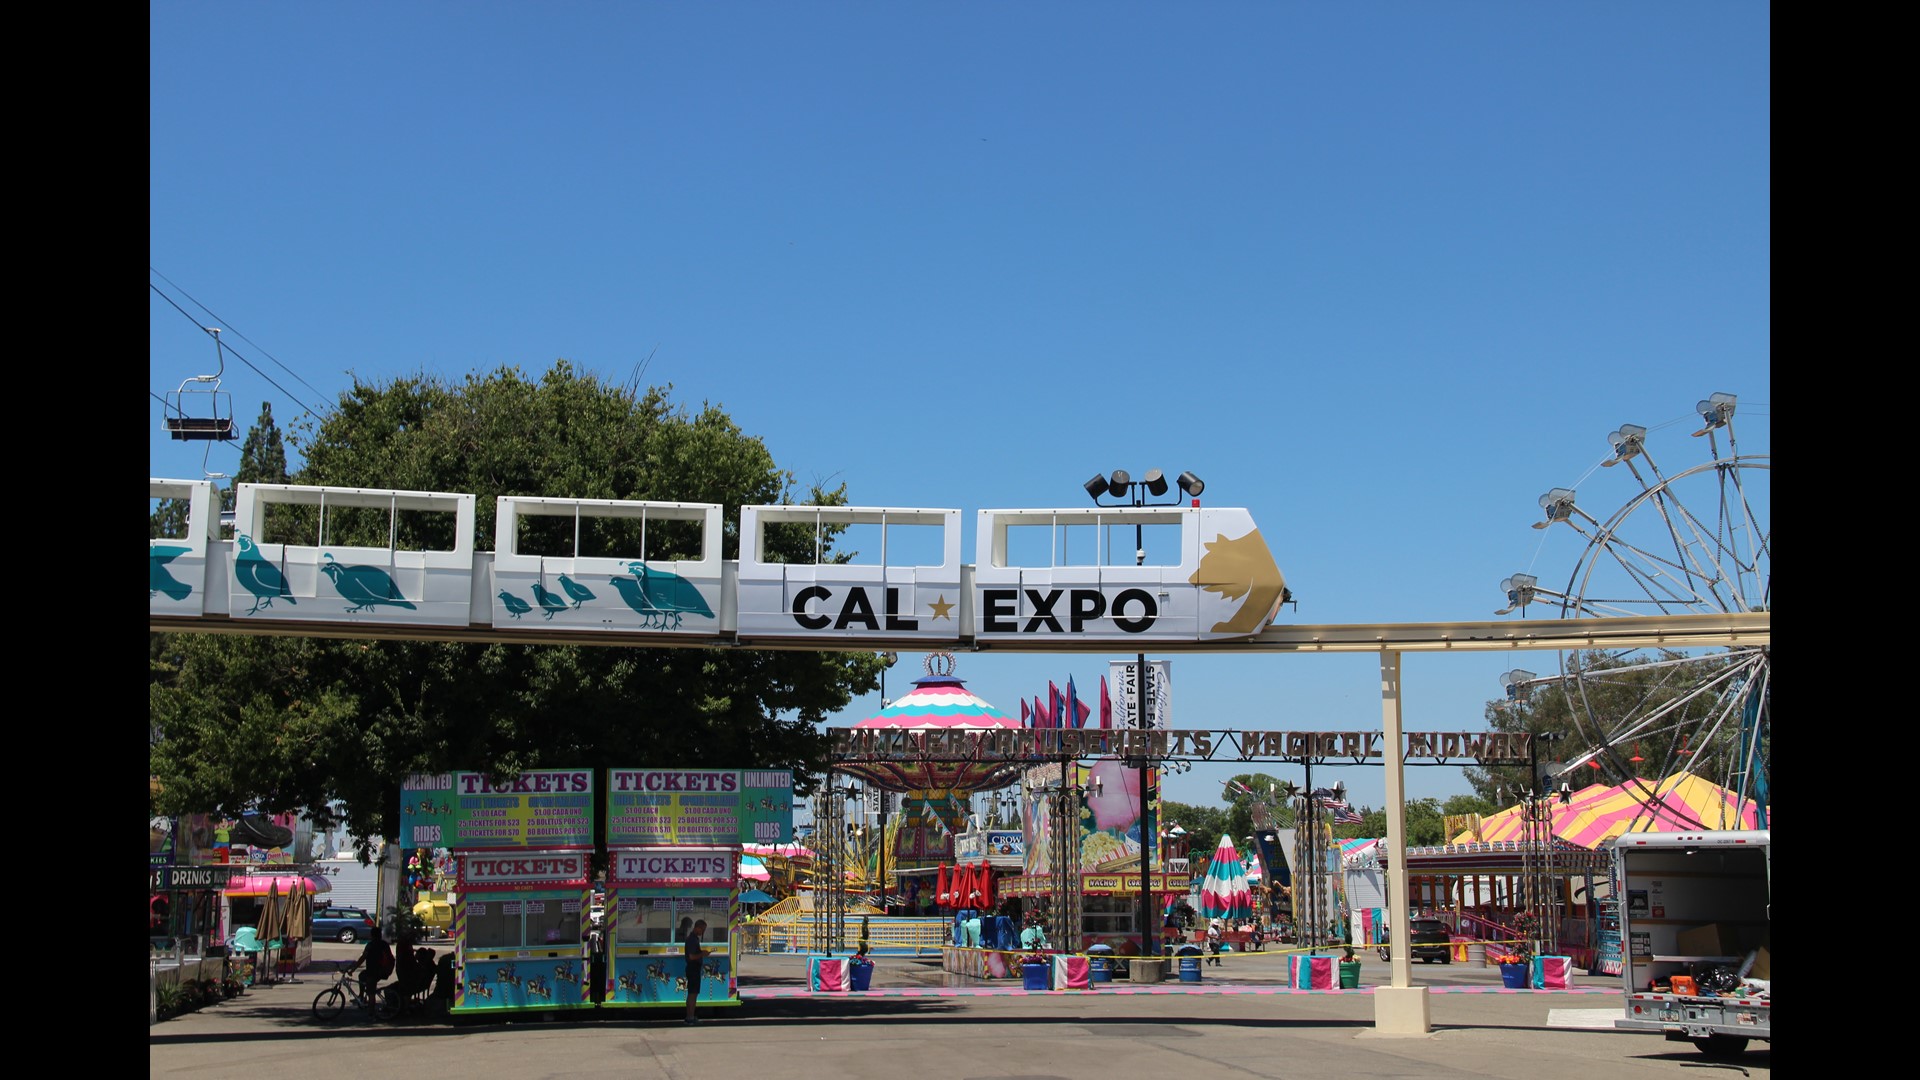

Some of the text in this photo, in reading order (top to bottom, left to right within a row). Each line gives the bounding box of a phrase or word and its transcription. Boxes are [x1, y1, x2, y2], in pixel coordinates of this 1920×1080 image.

[792, 585, 1158, 634] CAL EXPO
[1146, 666, 1156, 705] STATE
[1126, 665, 1136, 729] ATE FAIR
[1156, 671, 1168, 731] Californi
[831, 728, 1533, 759] BUTLER AMUSEMENTS MAGICAL MIDWAY
[404, 774, 453, 791] UNLIMITED
[615, 772, 737, 792] TICKETS
[744, 772, 791, 788] UNLIMITED
[491, 809, 507, 817] EACH
[552, 808, 569, 816] CADA
[643, 806, 659, 814] EACH
[468, 819, 494, 827] TICKETS
[494, 819, 507, 827] FOR
[527, 818, 535, 826] 25
[536, 818, 563, 826] BOLETOS
[576, 817, 589, 825] $23
[612, 816, 672, 824] 25 TICKETS FOR $23
[677, 816, 686, 824] 25
[686, 816, 712, 824] BOLETOS
[413, 825, 442, 842] RIDES
[468, 829, 494, 837] TICKETS
[507, 828, 520, 836] $70
[527, 828, 536, 836] 80
[536, 828, 563, 836] BOLETOS
[563, 827, 576, 835] POR
[622, 825, 646, 833] TICKETS
[647, 825, 659, 833] FOR
[659, 825, 672, 833] $70
[754, 822, 781, 838] RIDES
[471, 858, 577, 877] TICKETS
[623, 857, 725, 874] TICKETS
[171, 870, 212, 886] DRINKS
[1089, 879, 1118, 887] NACHOS
